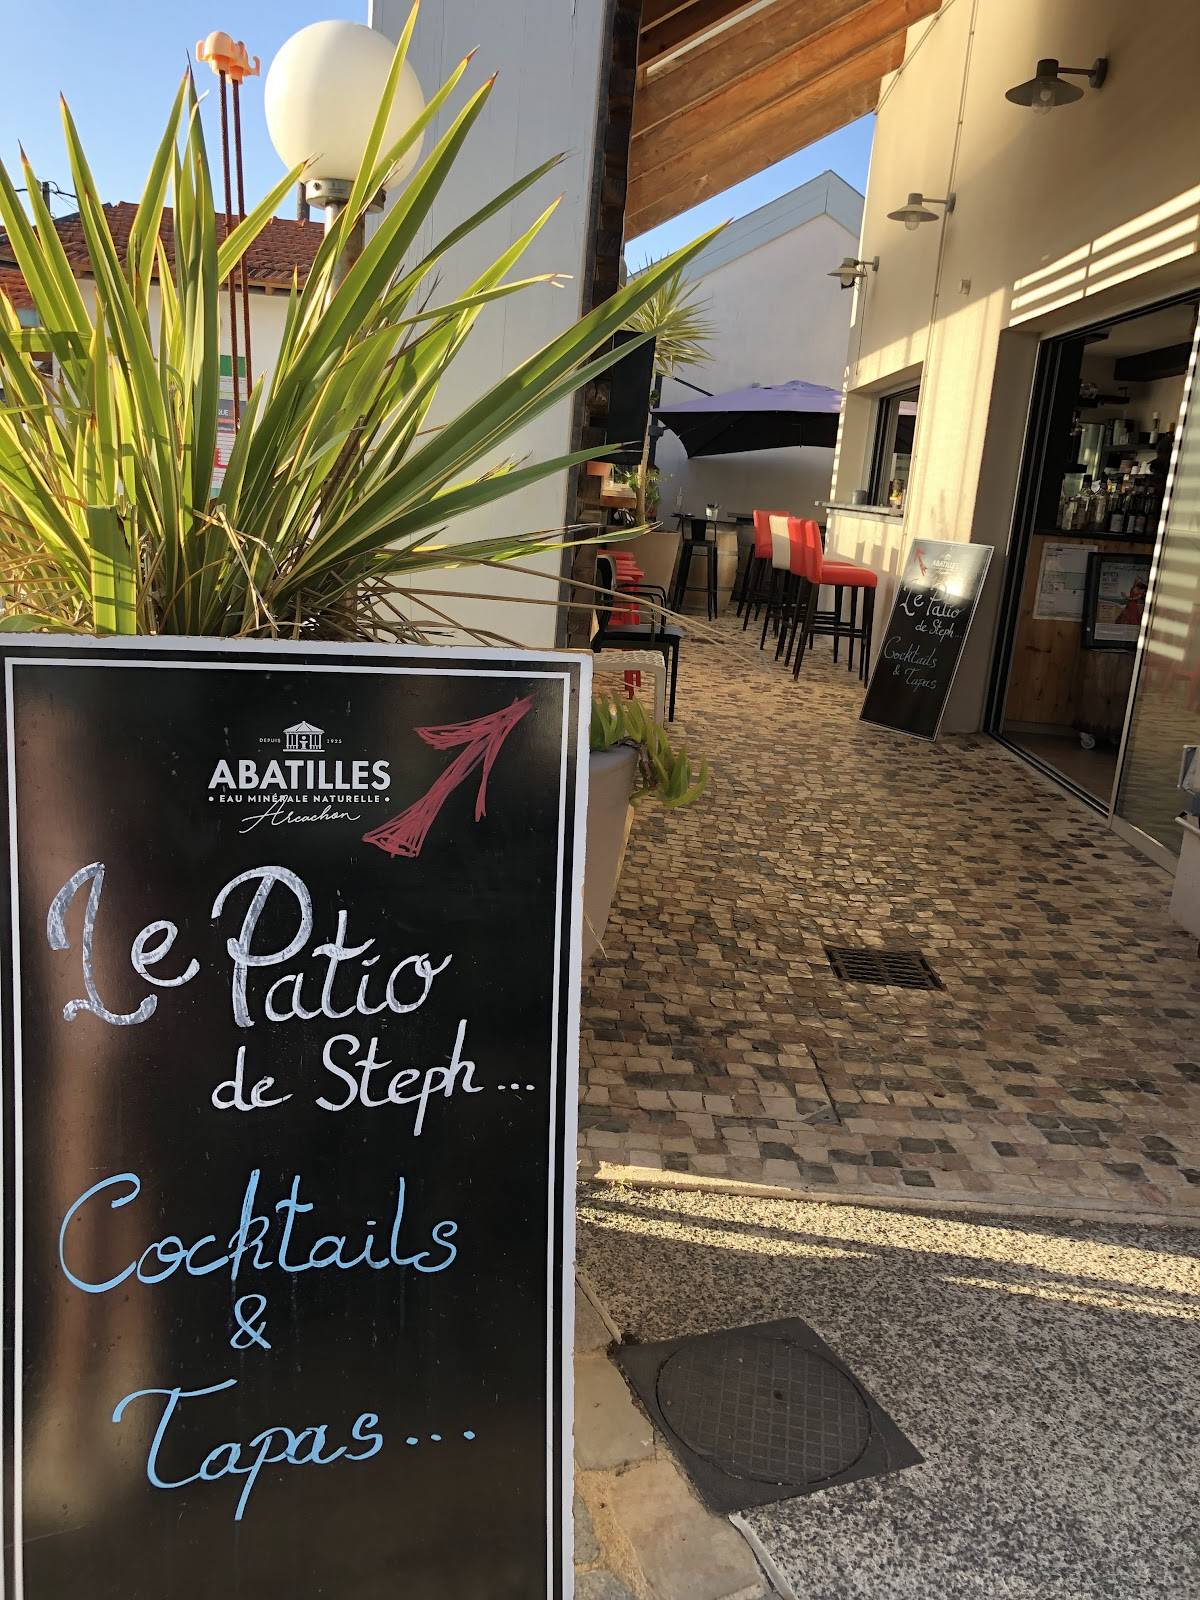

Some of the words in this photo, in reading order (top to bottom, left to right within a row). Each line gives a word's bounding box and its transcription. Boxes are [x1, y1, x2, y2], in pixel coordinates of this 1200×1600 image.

[900, 583, 924, 617] Le
[926, 582, 964, 618] Patio
[915, 620, 928, 633] de
[208, 759, 391, 791] ABATILLES
[219, 794, 243, 803] EAU
[313, 794, 381, 804] NATURELLE
[238, 794, 361, 834] Arcachon
[46, 861, 200, 1026] Le
[211, 865, 453, 1028] Patio
[211, 1045, 294, 1112] de
[59, 1168, 458, 1293] Cocktails
[229, 1293, 272, 1350] &
